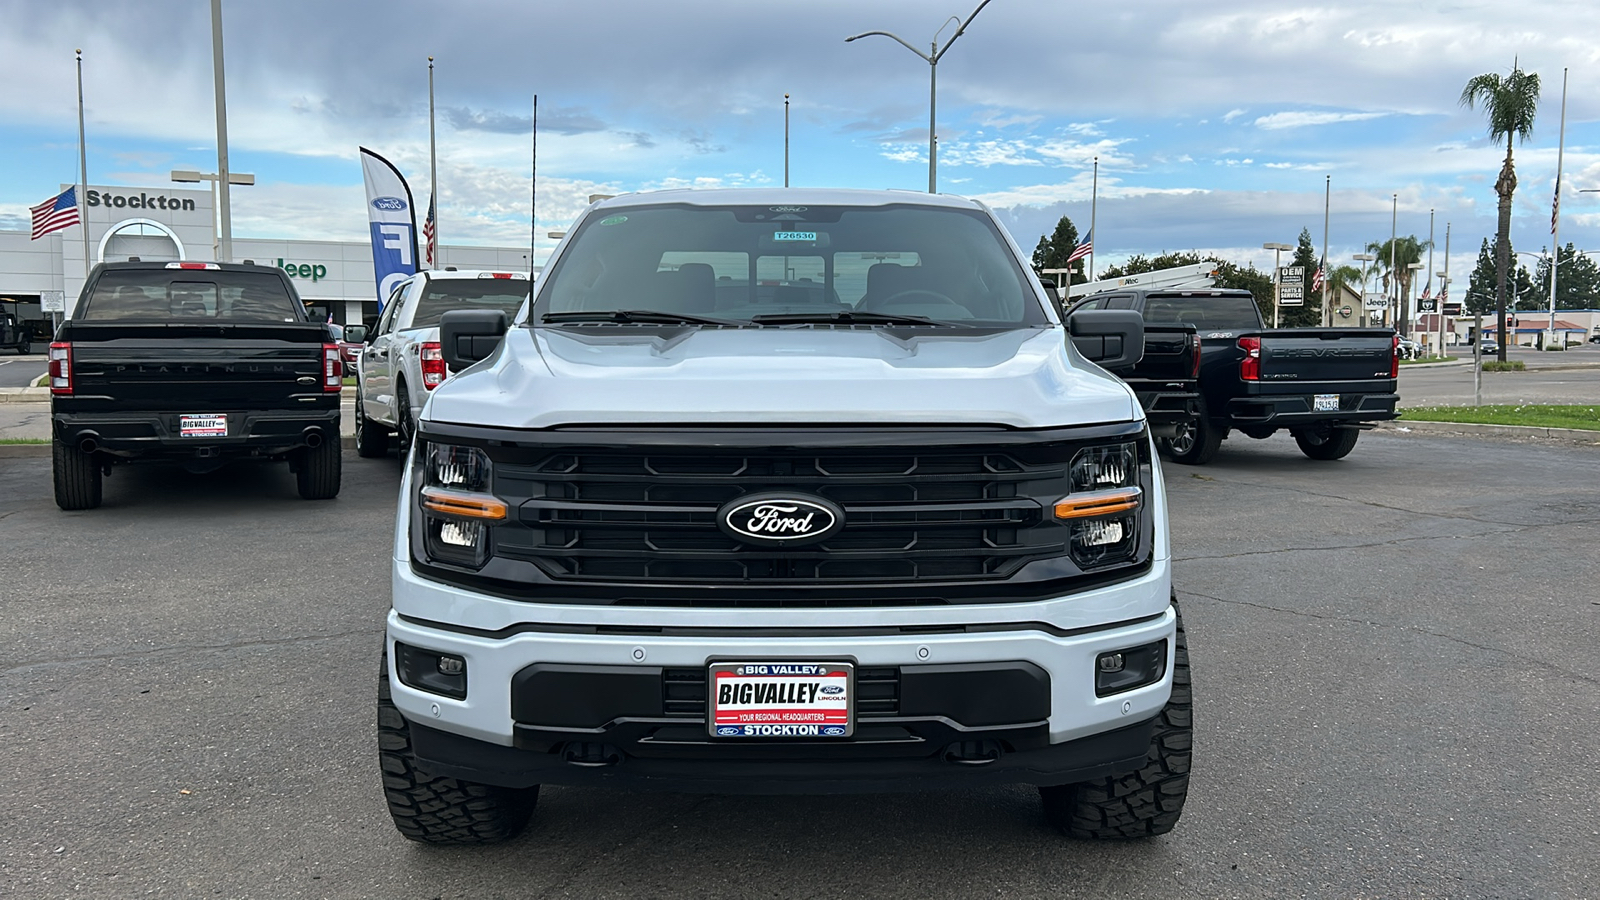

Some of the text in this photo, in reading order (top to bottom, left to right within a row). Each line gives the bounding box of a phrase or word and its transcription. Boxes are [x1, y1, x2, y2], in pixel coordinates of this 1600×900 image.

[87, 190, 195, 211] Stockton
[1281, 268, 1303, 276] OEM
[1366, 298, 1387, 307] Jeep
[116, 365, 284, 373] PLATINUM
[182, 420, 216, 428] BIGVALLEY
[747, 505, 814, 533] Ford
[745, 665, 818, 674] BIG VALLEY
[718, 683, 820, 705] BIGVALLEY
[755, 713, 781, 721] REGIONAL
[782, 713, 825, 721] HEADQUARTERS
[744, 725, 819, 735] STOCKTON
